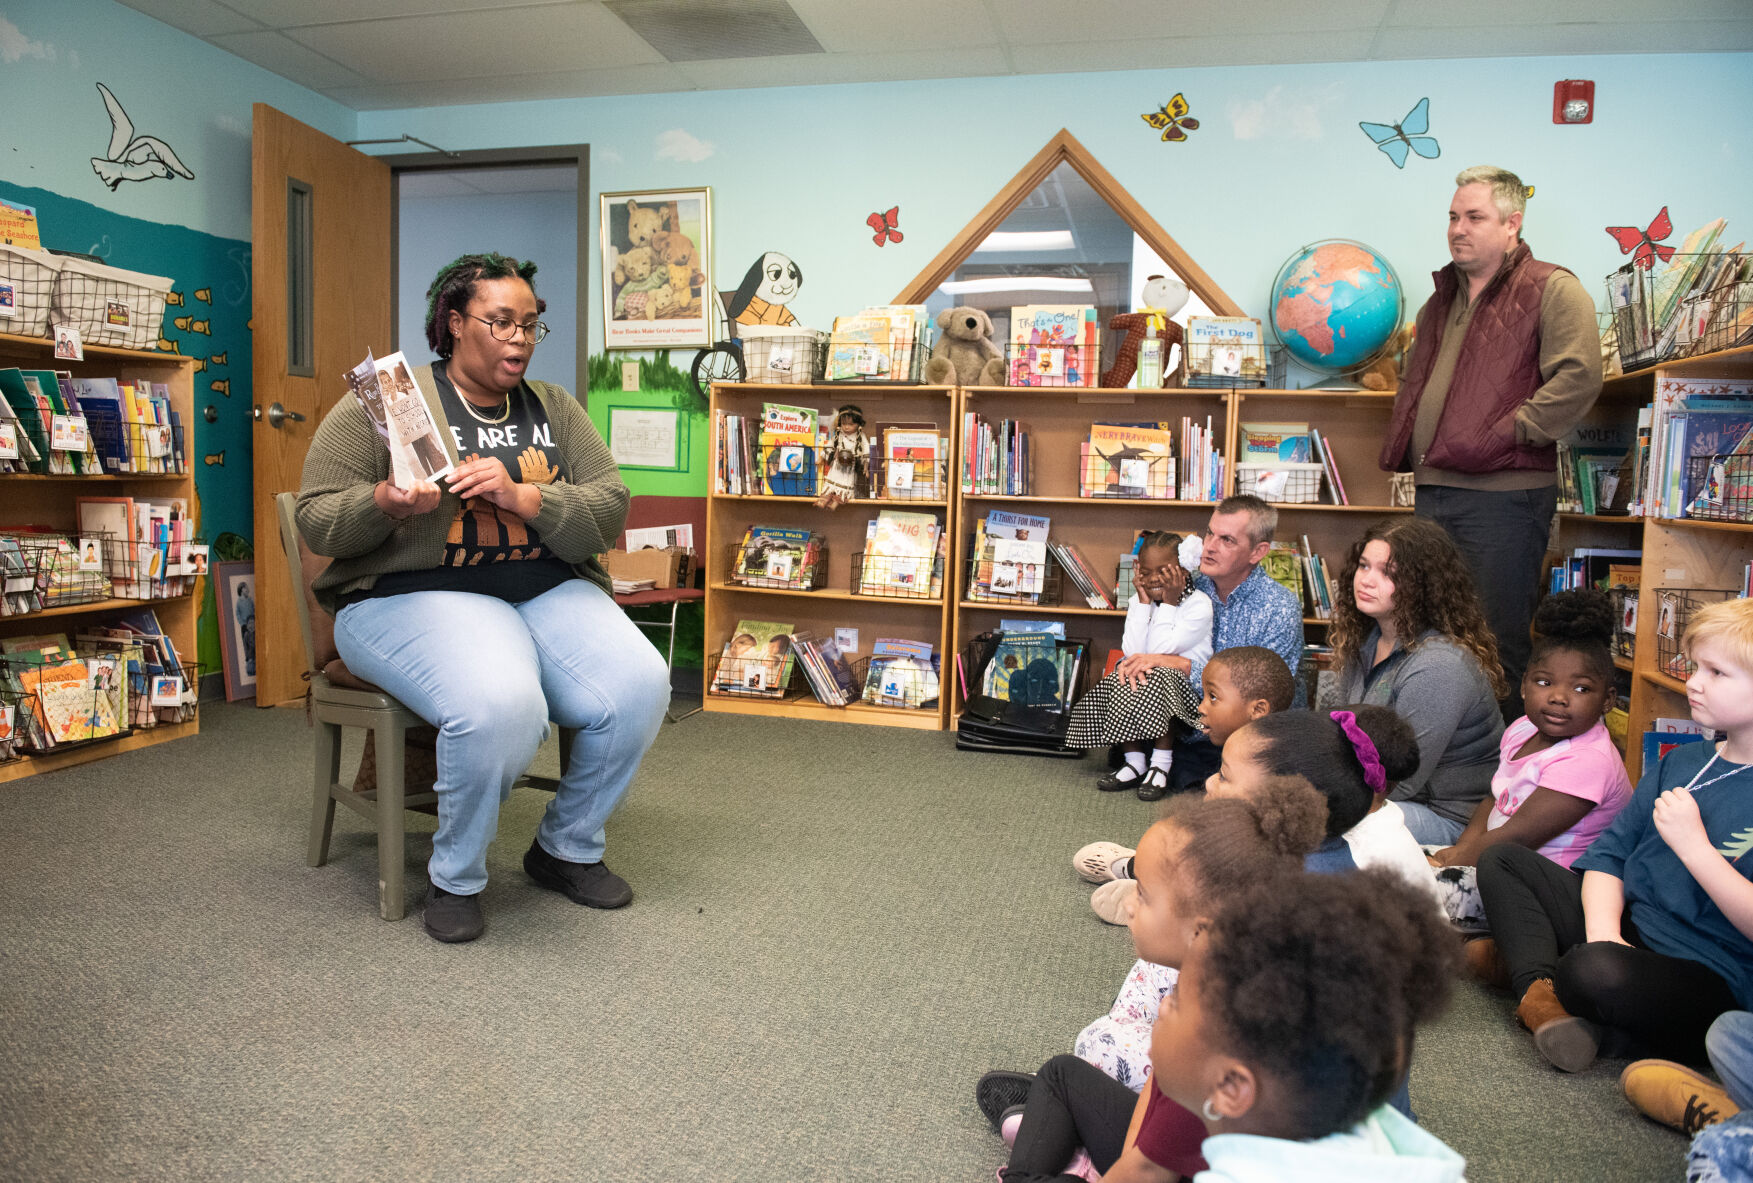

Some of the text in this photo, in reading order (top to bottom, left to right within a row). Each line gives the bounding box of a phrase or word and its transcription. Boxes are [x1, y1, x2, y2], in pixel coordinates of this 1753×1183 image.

[7, 229, 39, 241] Seashore
[1054, 309, 1080, 324] One!
[1196, 328, 1254, 339] First Dog
[780, 414, 798, 422] Explore
[763, 420, 812, 433] SOUTH AMERICA
[449, 422, 558, 451] E ARE AL
[1120, 431, 1147, 442] BRAVE
[992, 512, 998, 522] A
[998, 513, 1017, 525] THIRST
[1017, 516, 1029, 527] FOR
[1029, 517, 1046, 529] HOME
[1616, 574, 1635, 583] Top
